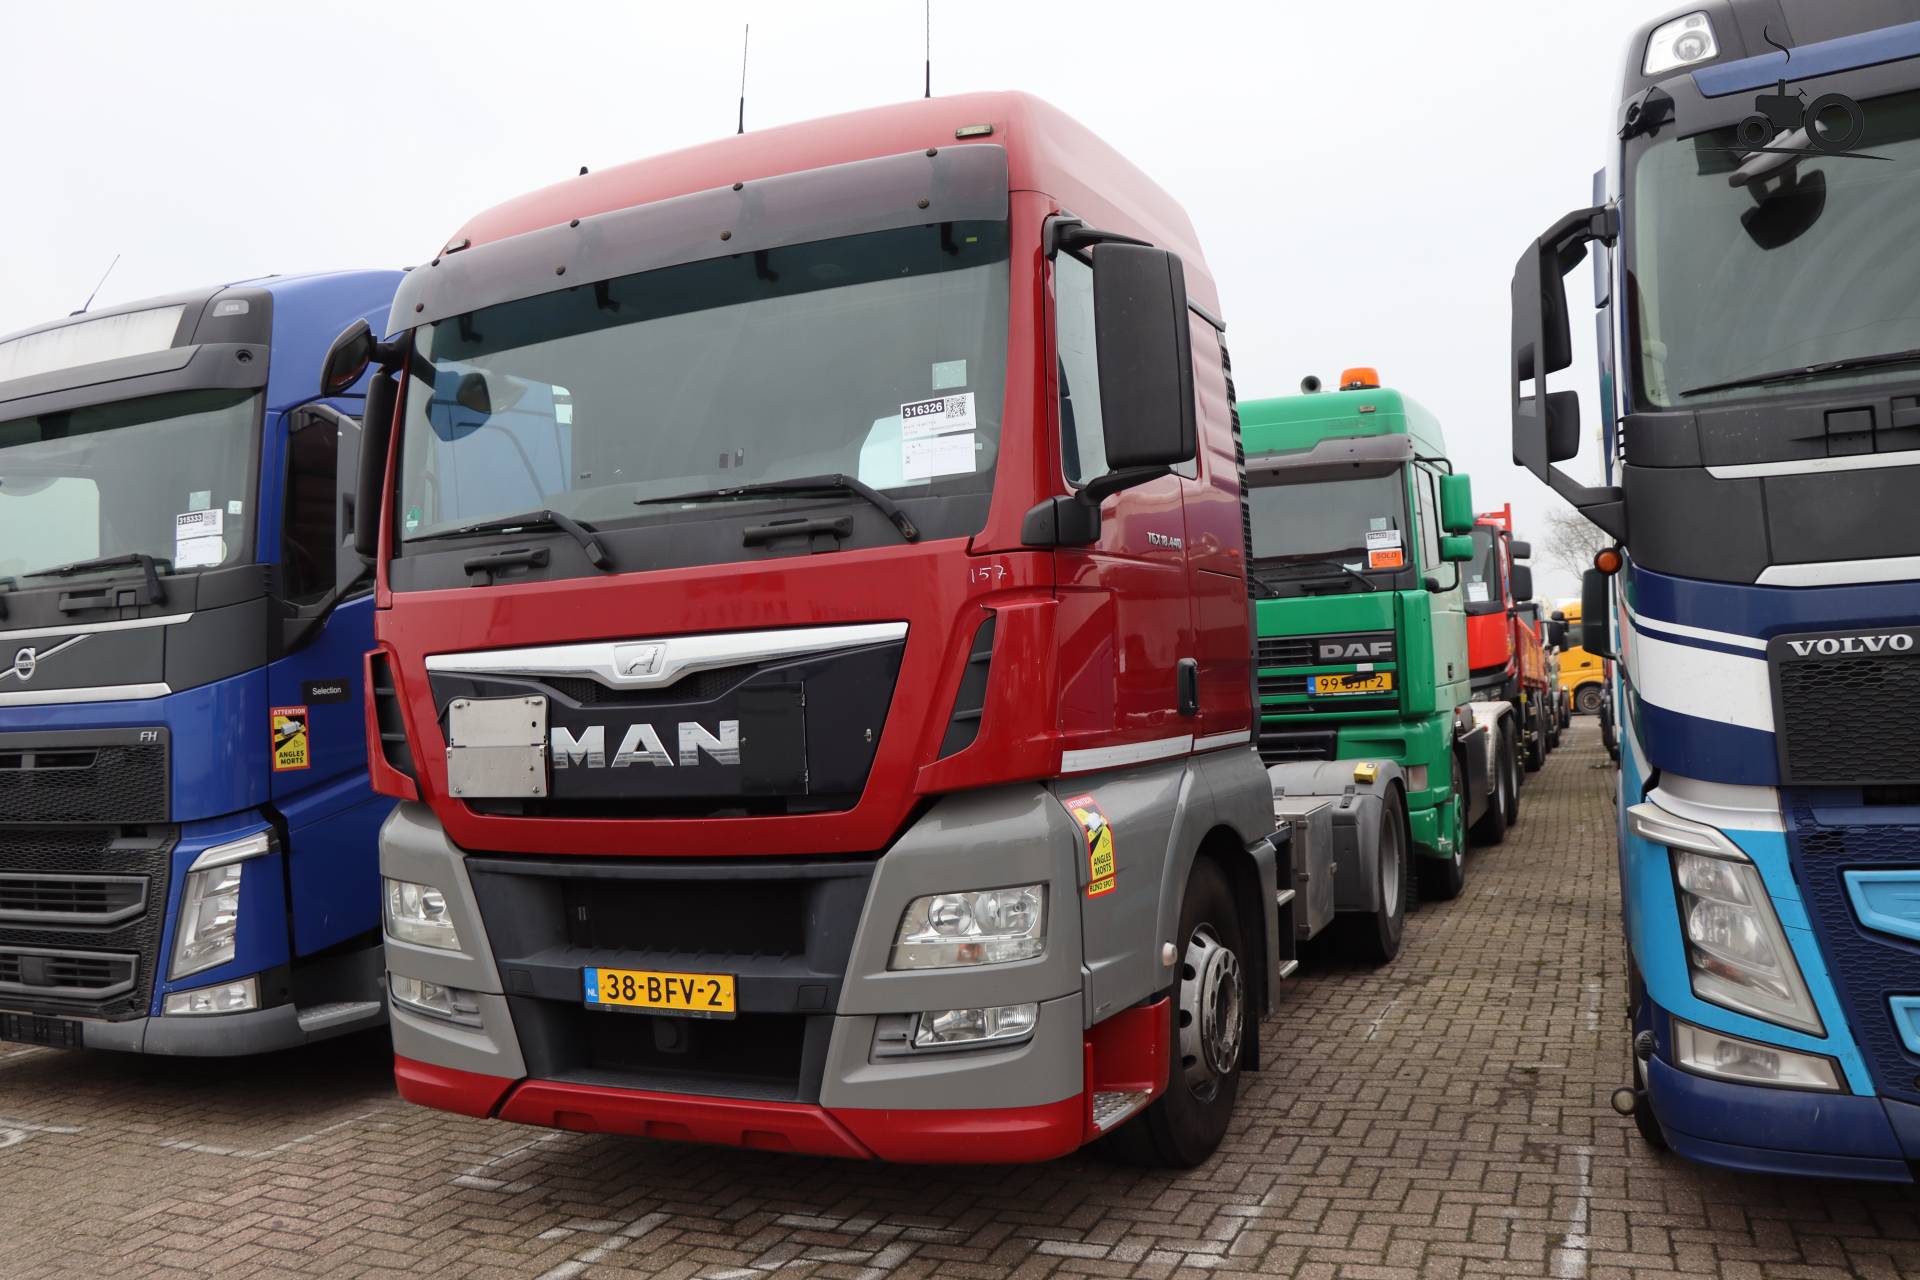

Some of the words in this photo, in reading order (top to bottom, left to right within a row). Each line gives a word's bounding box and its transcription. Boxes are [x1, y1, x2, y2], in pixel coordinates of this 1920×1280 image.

[904, 402, 943, 417] 316326
[970, 565, 1007, 584] 157
[1320, 641, 1393, 659] DAF
[1786, 633, 1914, 657] VOLVO
[312, 686, 342, 696] Selection
[273, 708, 306, 716] ATTENTION
[140, 731, 158, 742] FH
[551, 720, 741, 769] MAN
[279, 750, 305, 759] ANGLES
[280, 757, 304, 766] MORTS
[1094, 852, 1112, 866] ANGLES
[1095, 863, 1112, 876] MORTS
[587, 988, 598, 997] NL
[607, 974, 723, 1007] 38-BFV-2
